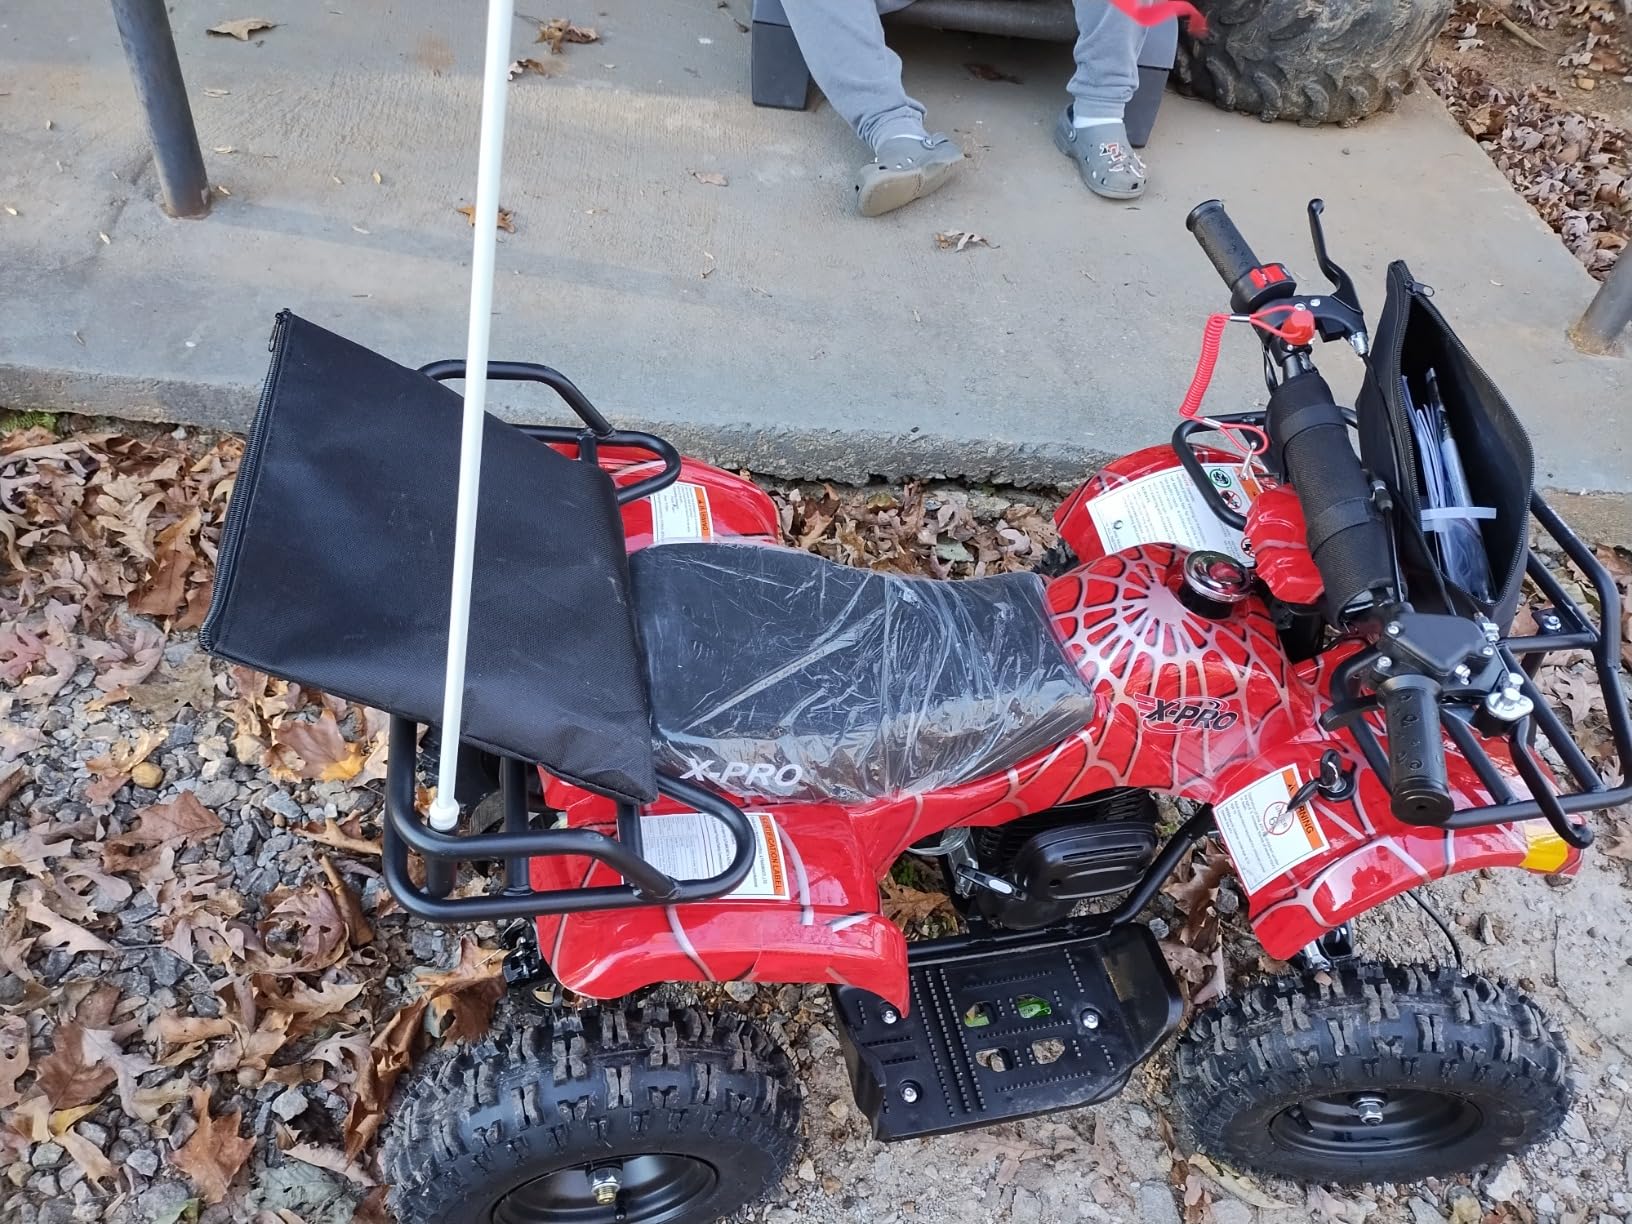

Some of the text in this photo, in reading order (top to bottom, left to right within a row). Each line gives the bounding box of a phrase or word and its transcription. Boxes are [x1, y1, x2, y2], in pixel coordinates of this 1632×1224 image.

[1144, 699, 1238, 731] X-PRO
[679, 758, 803, 787] X-PRO
[772, 864, 783, 890] LABEL
